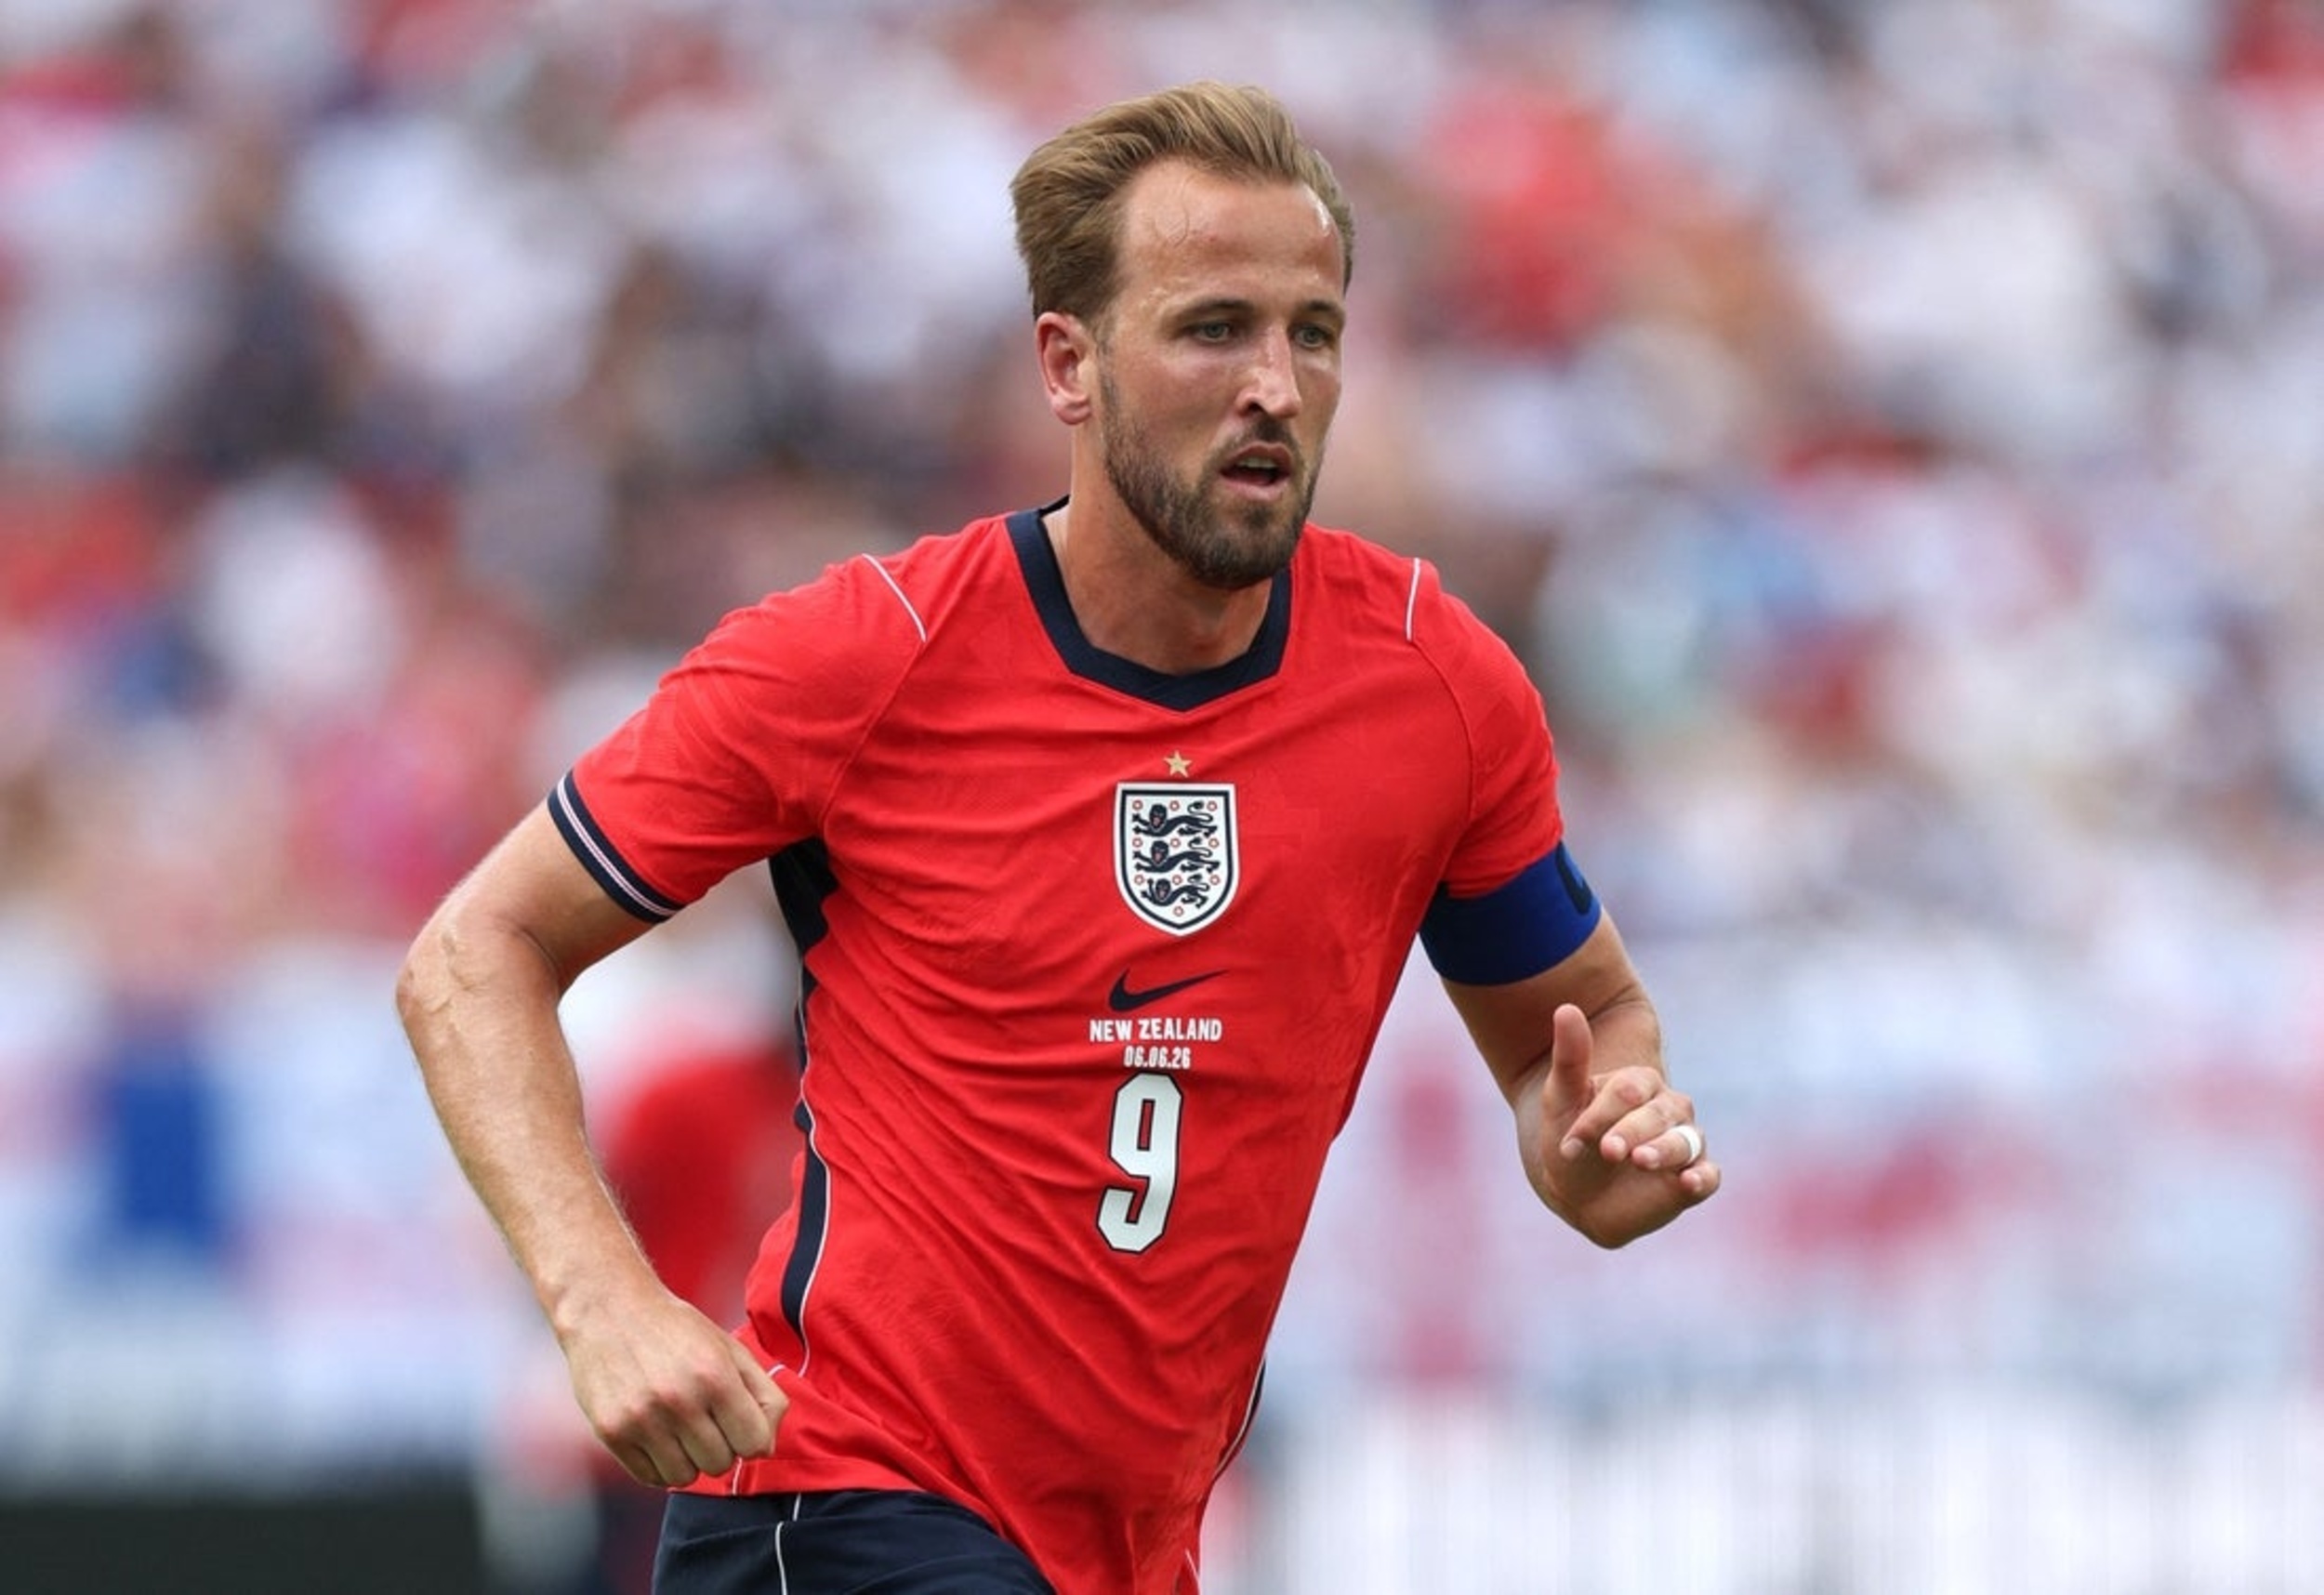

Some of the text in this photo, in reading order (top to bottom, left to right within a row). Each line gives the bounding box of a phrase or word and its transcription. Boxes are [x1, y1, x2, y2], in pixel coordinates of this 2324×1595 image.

[1089, 1018, 1222, 1042] NEW ZEALAND
[1123, 1046, 1191, 1069] 06.06.26
[1096, 1071, 1184, 1255] 9
